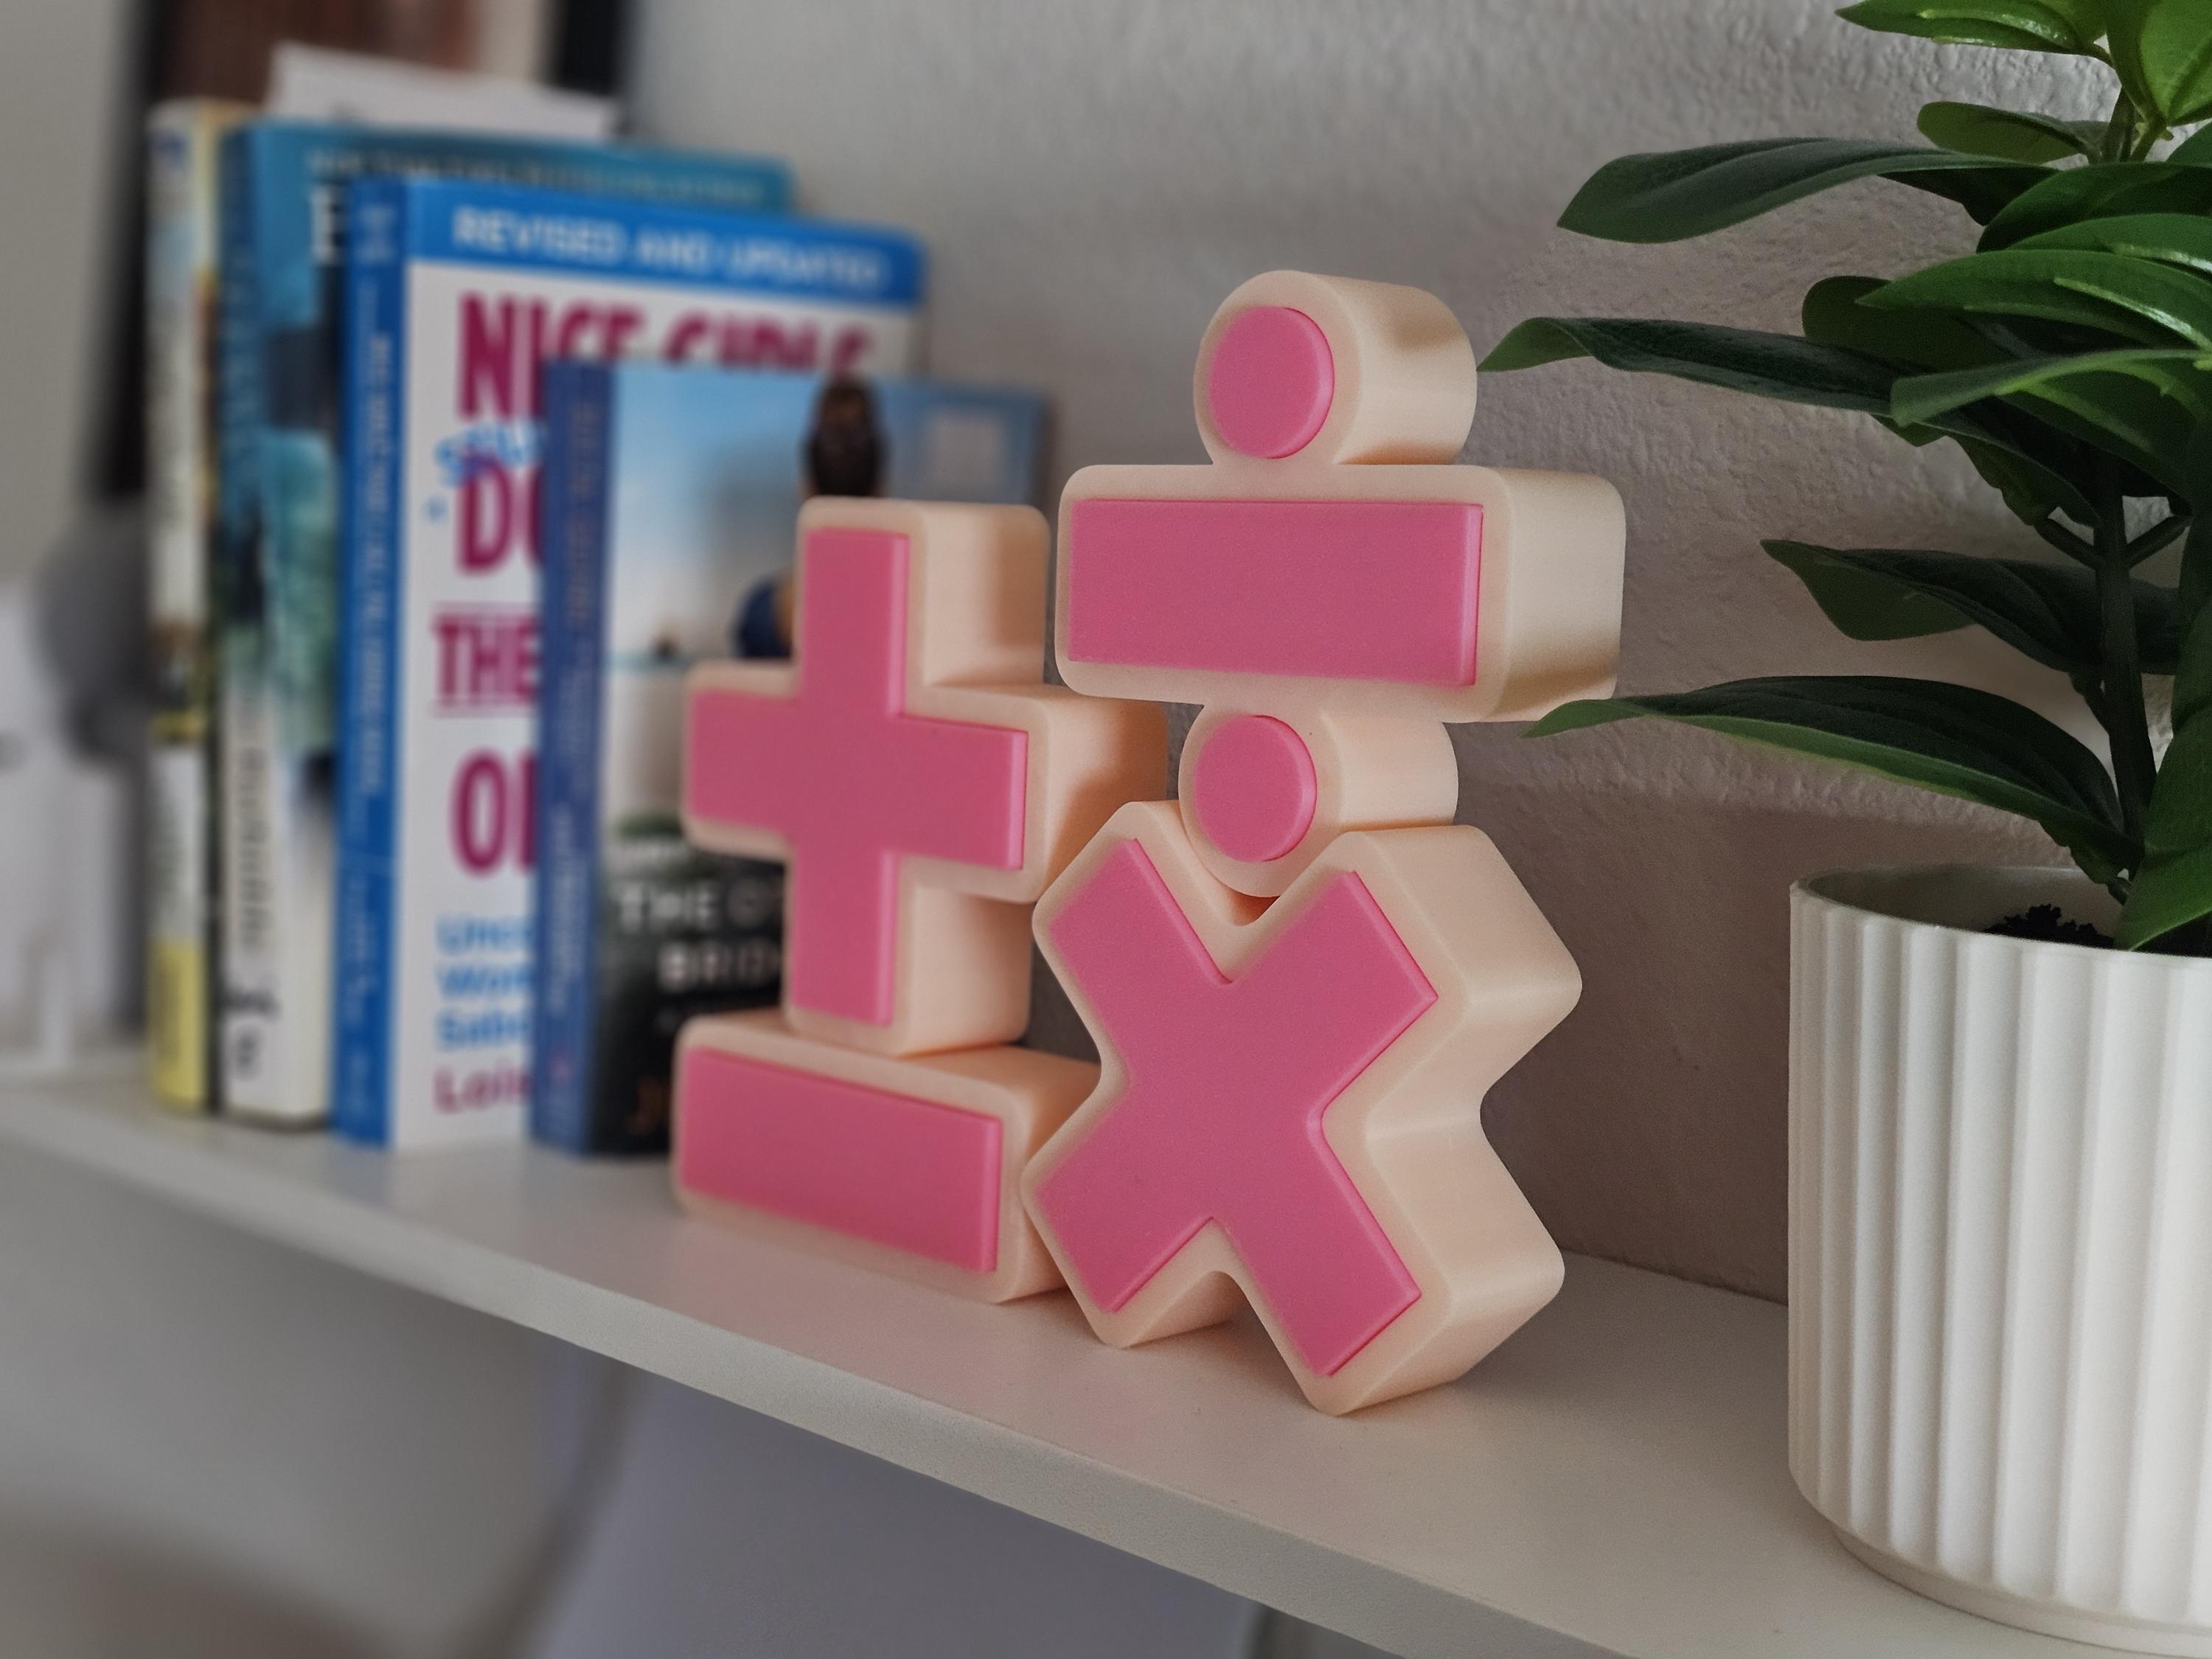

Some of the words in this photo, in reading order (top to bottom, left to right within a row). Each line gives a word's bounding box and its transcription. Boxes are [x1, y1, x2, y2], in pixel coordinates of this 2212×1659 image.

[451, 205, 627, 265] REVISED
[634, 227, 712, 274] AND
[726, 237, 890, 293] UPDATED
